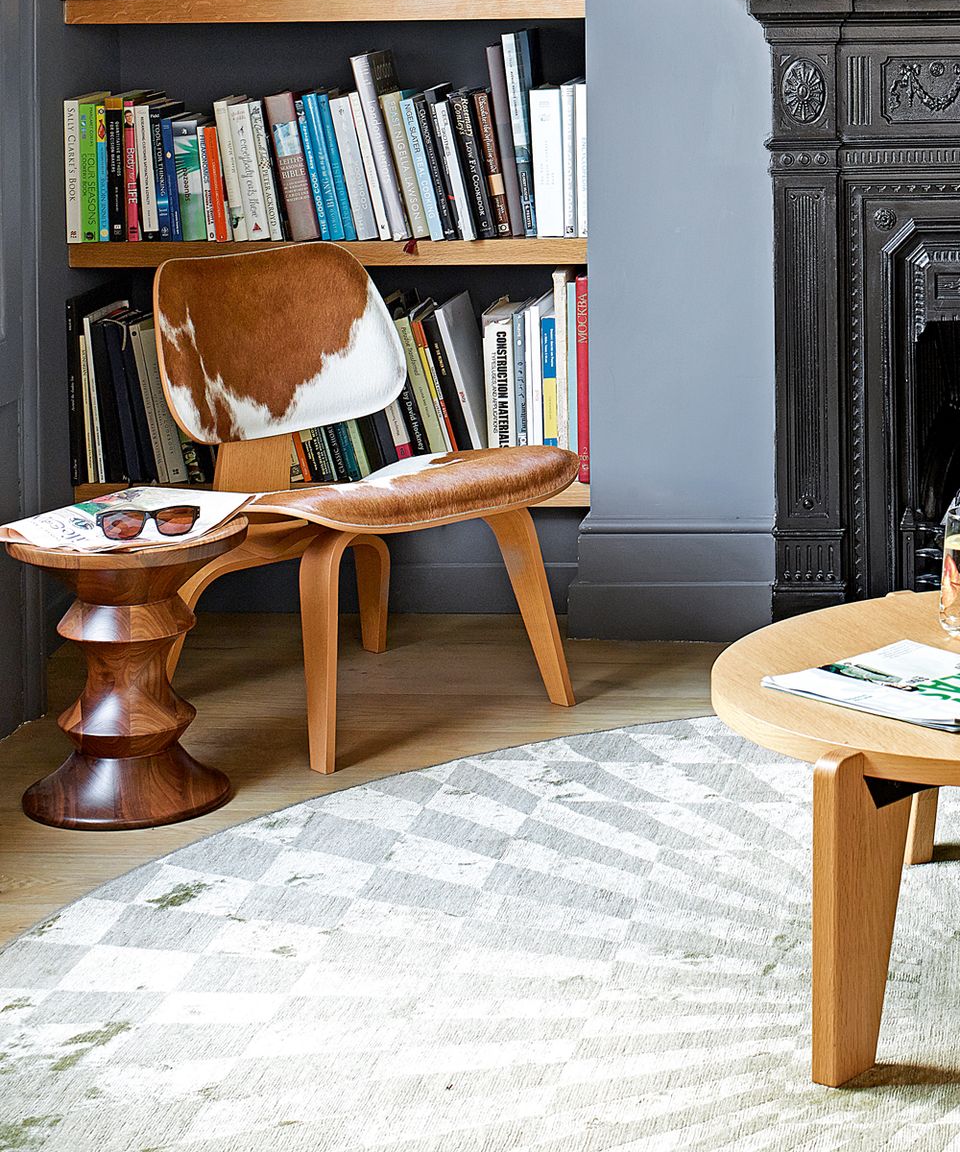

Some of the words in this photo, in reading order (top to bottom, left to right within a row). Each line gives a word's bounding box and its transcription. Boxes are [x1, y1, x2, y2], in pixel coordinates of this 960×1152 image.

[67, 107, 76, 133] SALLY
[404, 103, 414, 126] NIGEL
[460, 97, 475, 138] Rosemary
[68, 134, 78, 174] CLARKE'S
[408, 127, 421, 154] SLATER
[87, 153, 96, 179] FOUR
[126, 147, 136, 170] Body
[69, 177, 78, 202] BOOK
[87, 181, 98, 225] SEASONS
[127, 182, 137, 204] LIFE
[403, 176, 422, 221] LAWSON
[496, 330, 509, 404] CONSTRUCTION
[498, 405, 511, 449] MATERIALS
